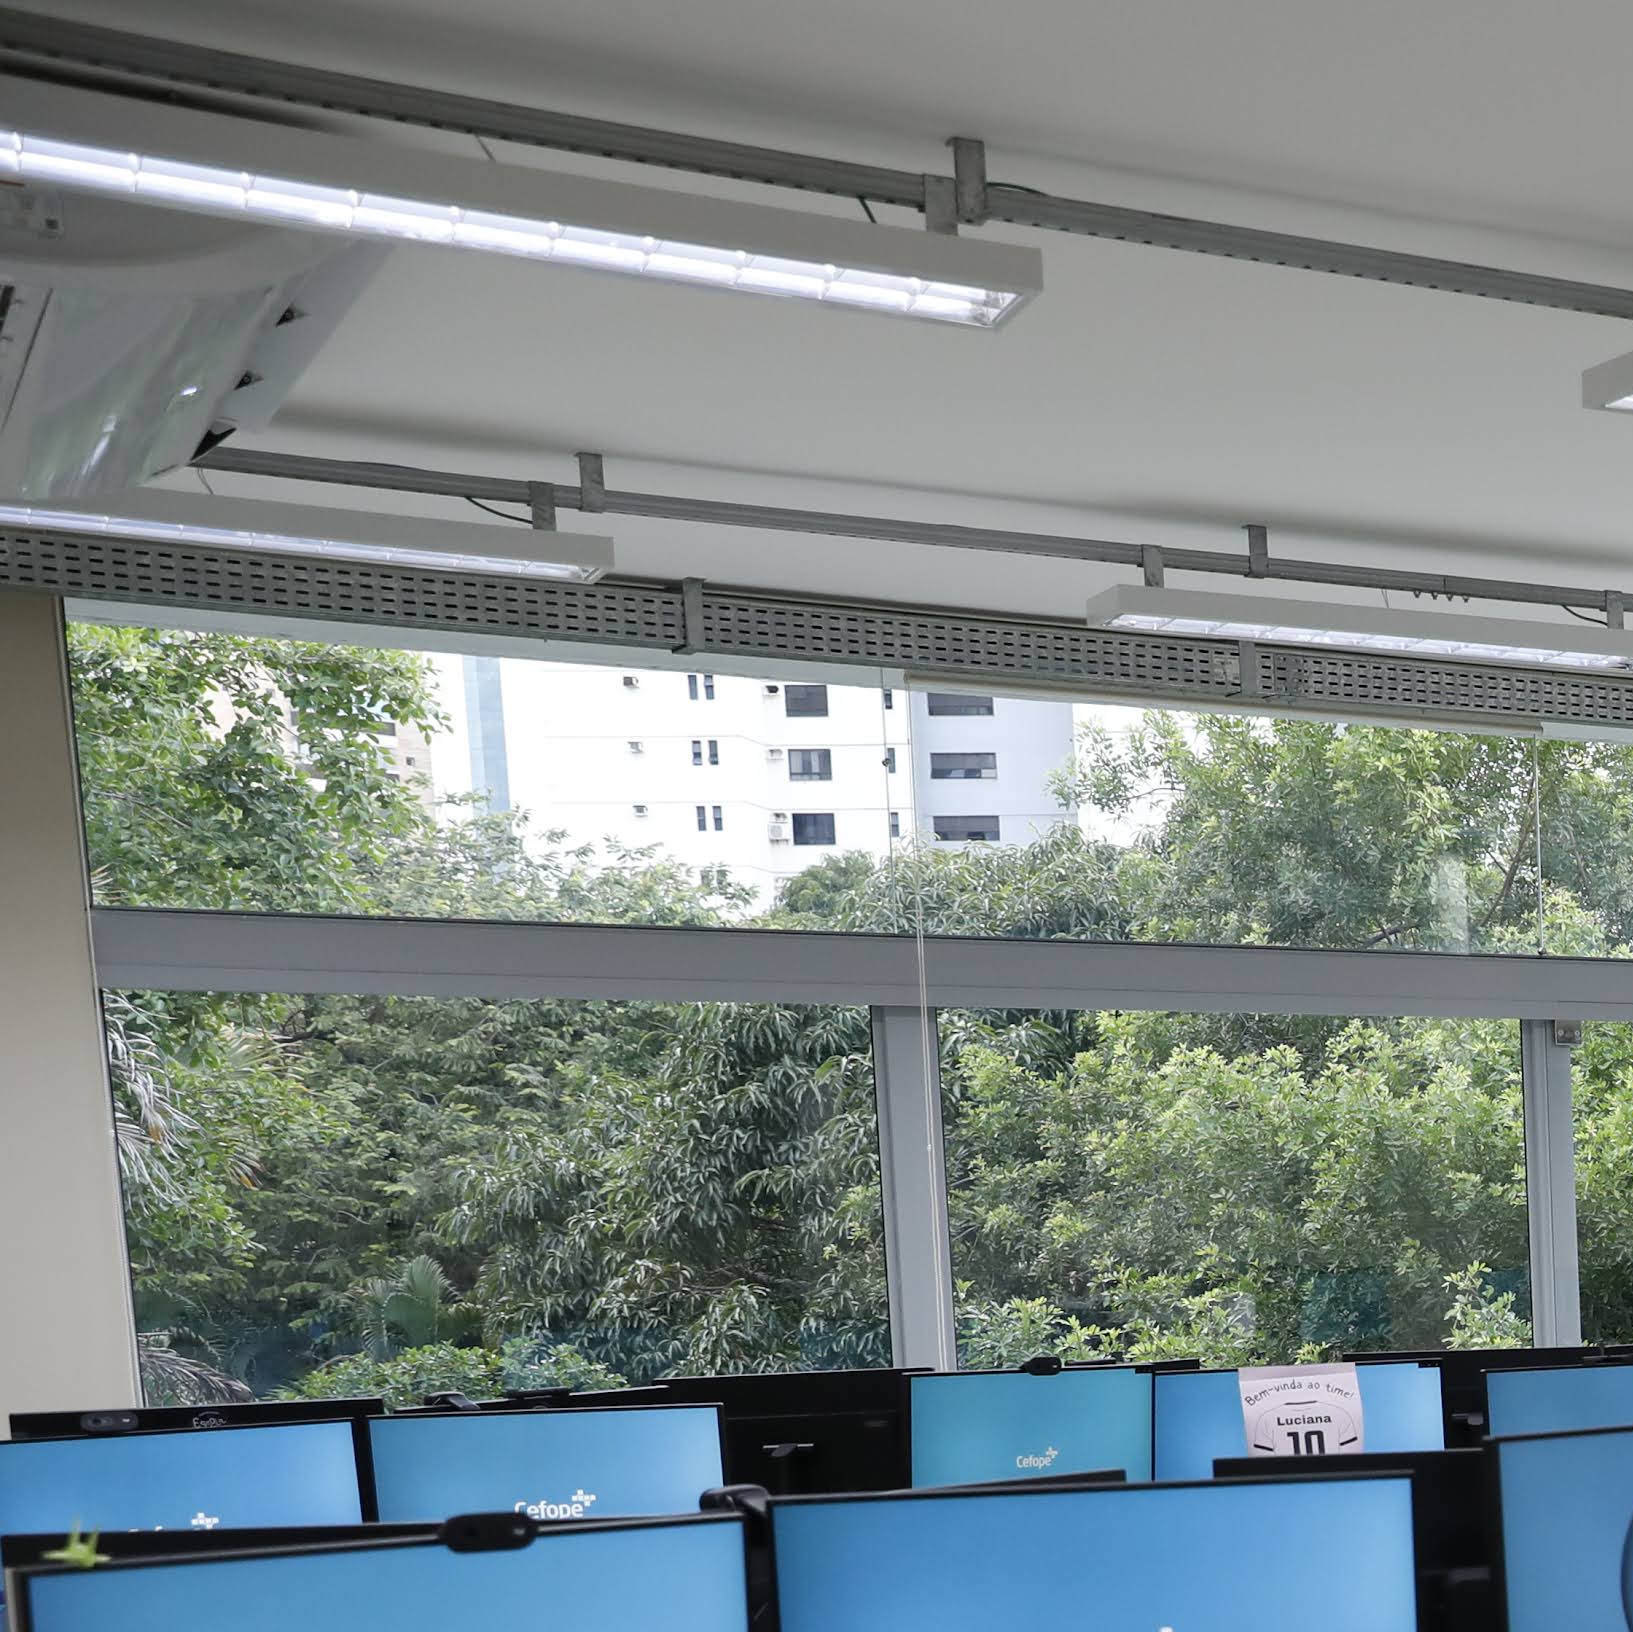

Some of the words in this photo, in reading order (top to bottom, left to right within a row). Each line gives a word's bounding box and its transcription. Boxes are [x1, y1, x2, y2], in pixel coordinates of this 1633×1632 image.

[1244, 1379, 1303, 1406] Bem-vinda
[1307, 1382, 1321, 1390] ao
[1326, 1384, 1355, 1399] time!
[1276, 1415, 1332, 1426] Luciana
[1286, 1430, 1325, 1455] 10
[1016, 1455, 1052, 1469] Cefope
